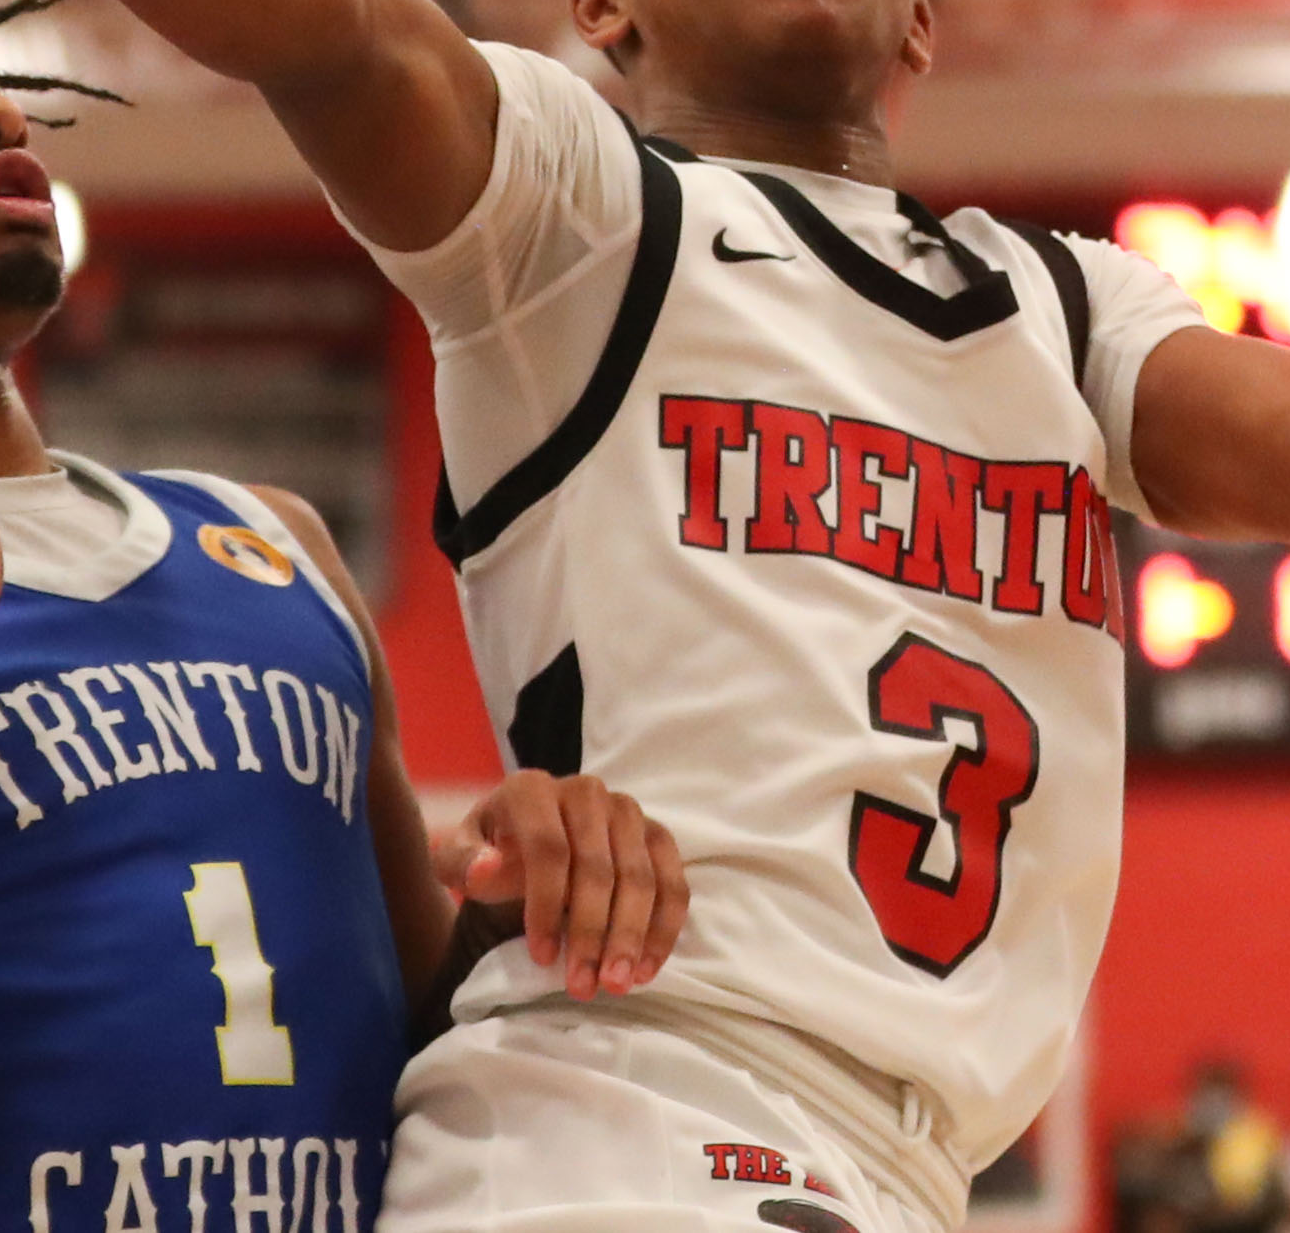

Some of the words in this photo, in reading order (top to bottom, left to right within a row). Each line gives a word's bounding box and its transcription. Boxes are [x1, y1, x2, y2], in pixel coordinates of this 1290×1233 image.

[658, 393, 1125, 649] TRENTO
[848, 630, 1040, 979] 3
[182, 861, 294, 1086] 1
[28, 1137, 388, 1233] CATHOL
[703, 1143, 791, 1185] THE
